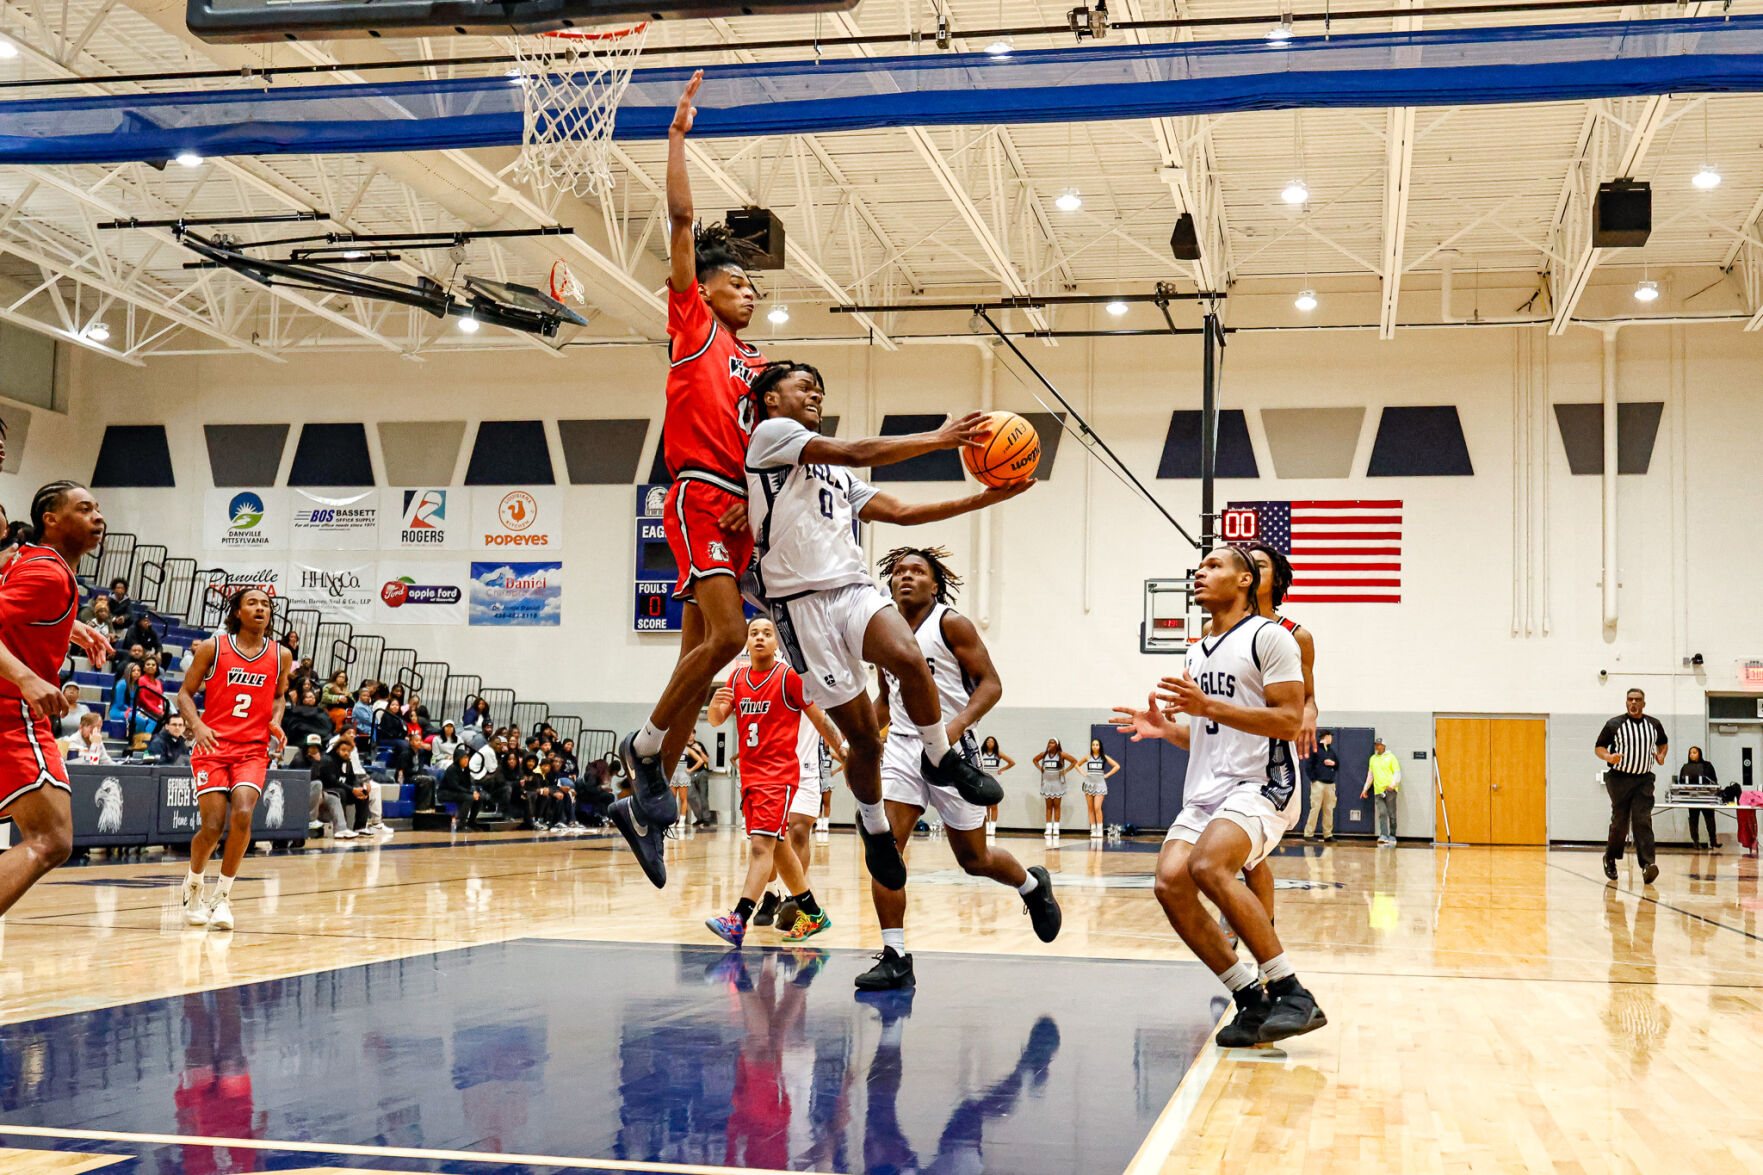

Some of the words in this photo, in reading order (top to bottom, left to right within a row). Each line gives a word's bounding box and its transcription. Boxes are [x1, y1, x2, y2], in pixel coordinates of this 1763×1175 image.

[1010, 442, 1041, 472] ilson
[818, 488, 833, 520] 0
[310, 509, 336, 522] BOS
[1226, 512, 1255, 537] 00
[402, 530, 444, 543] ROGERS
[642, 526, 666, 538] EAG
[210, 568, 278, 582] Danville
[506, 577, 546, 589] Daniel
[639, 584, 667, 593] FOULS
[209, 584, 277, 598] TOYTA
[408, 588, 436, 600] apple
[438, 588, 458, 598] ford
[650, 596, 660, 616] 0
[638, 619, 667, 629] SCORE
[228, 672, 267, 687] VILLE
[1194, 672, 1236, 698] GLES
[232, 694, 252, 718] 2
[740, 702, 770, 715] VILLE
[746, 722, 759, 747] 3
[168, 778, 190, 790] GEORGE
[167, 790, 190, 806] HIGH
[172, 810, 188, 829] Home
